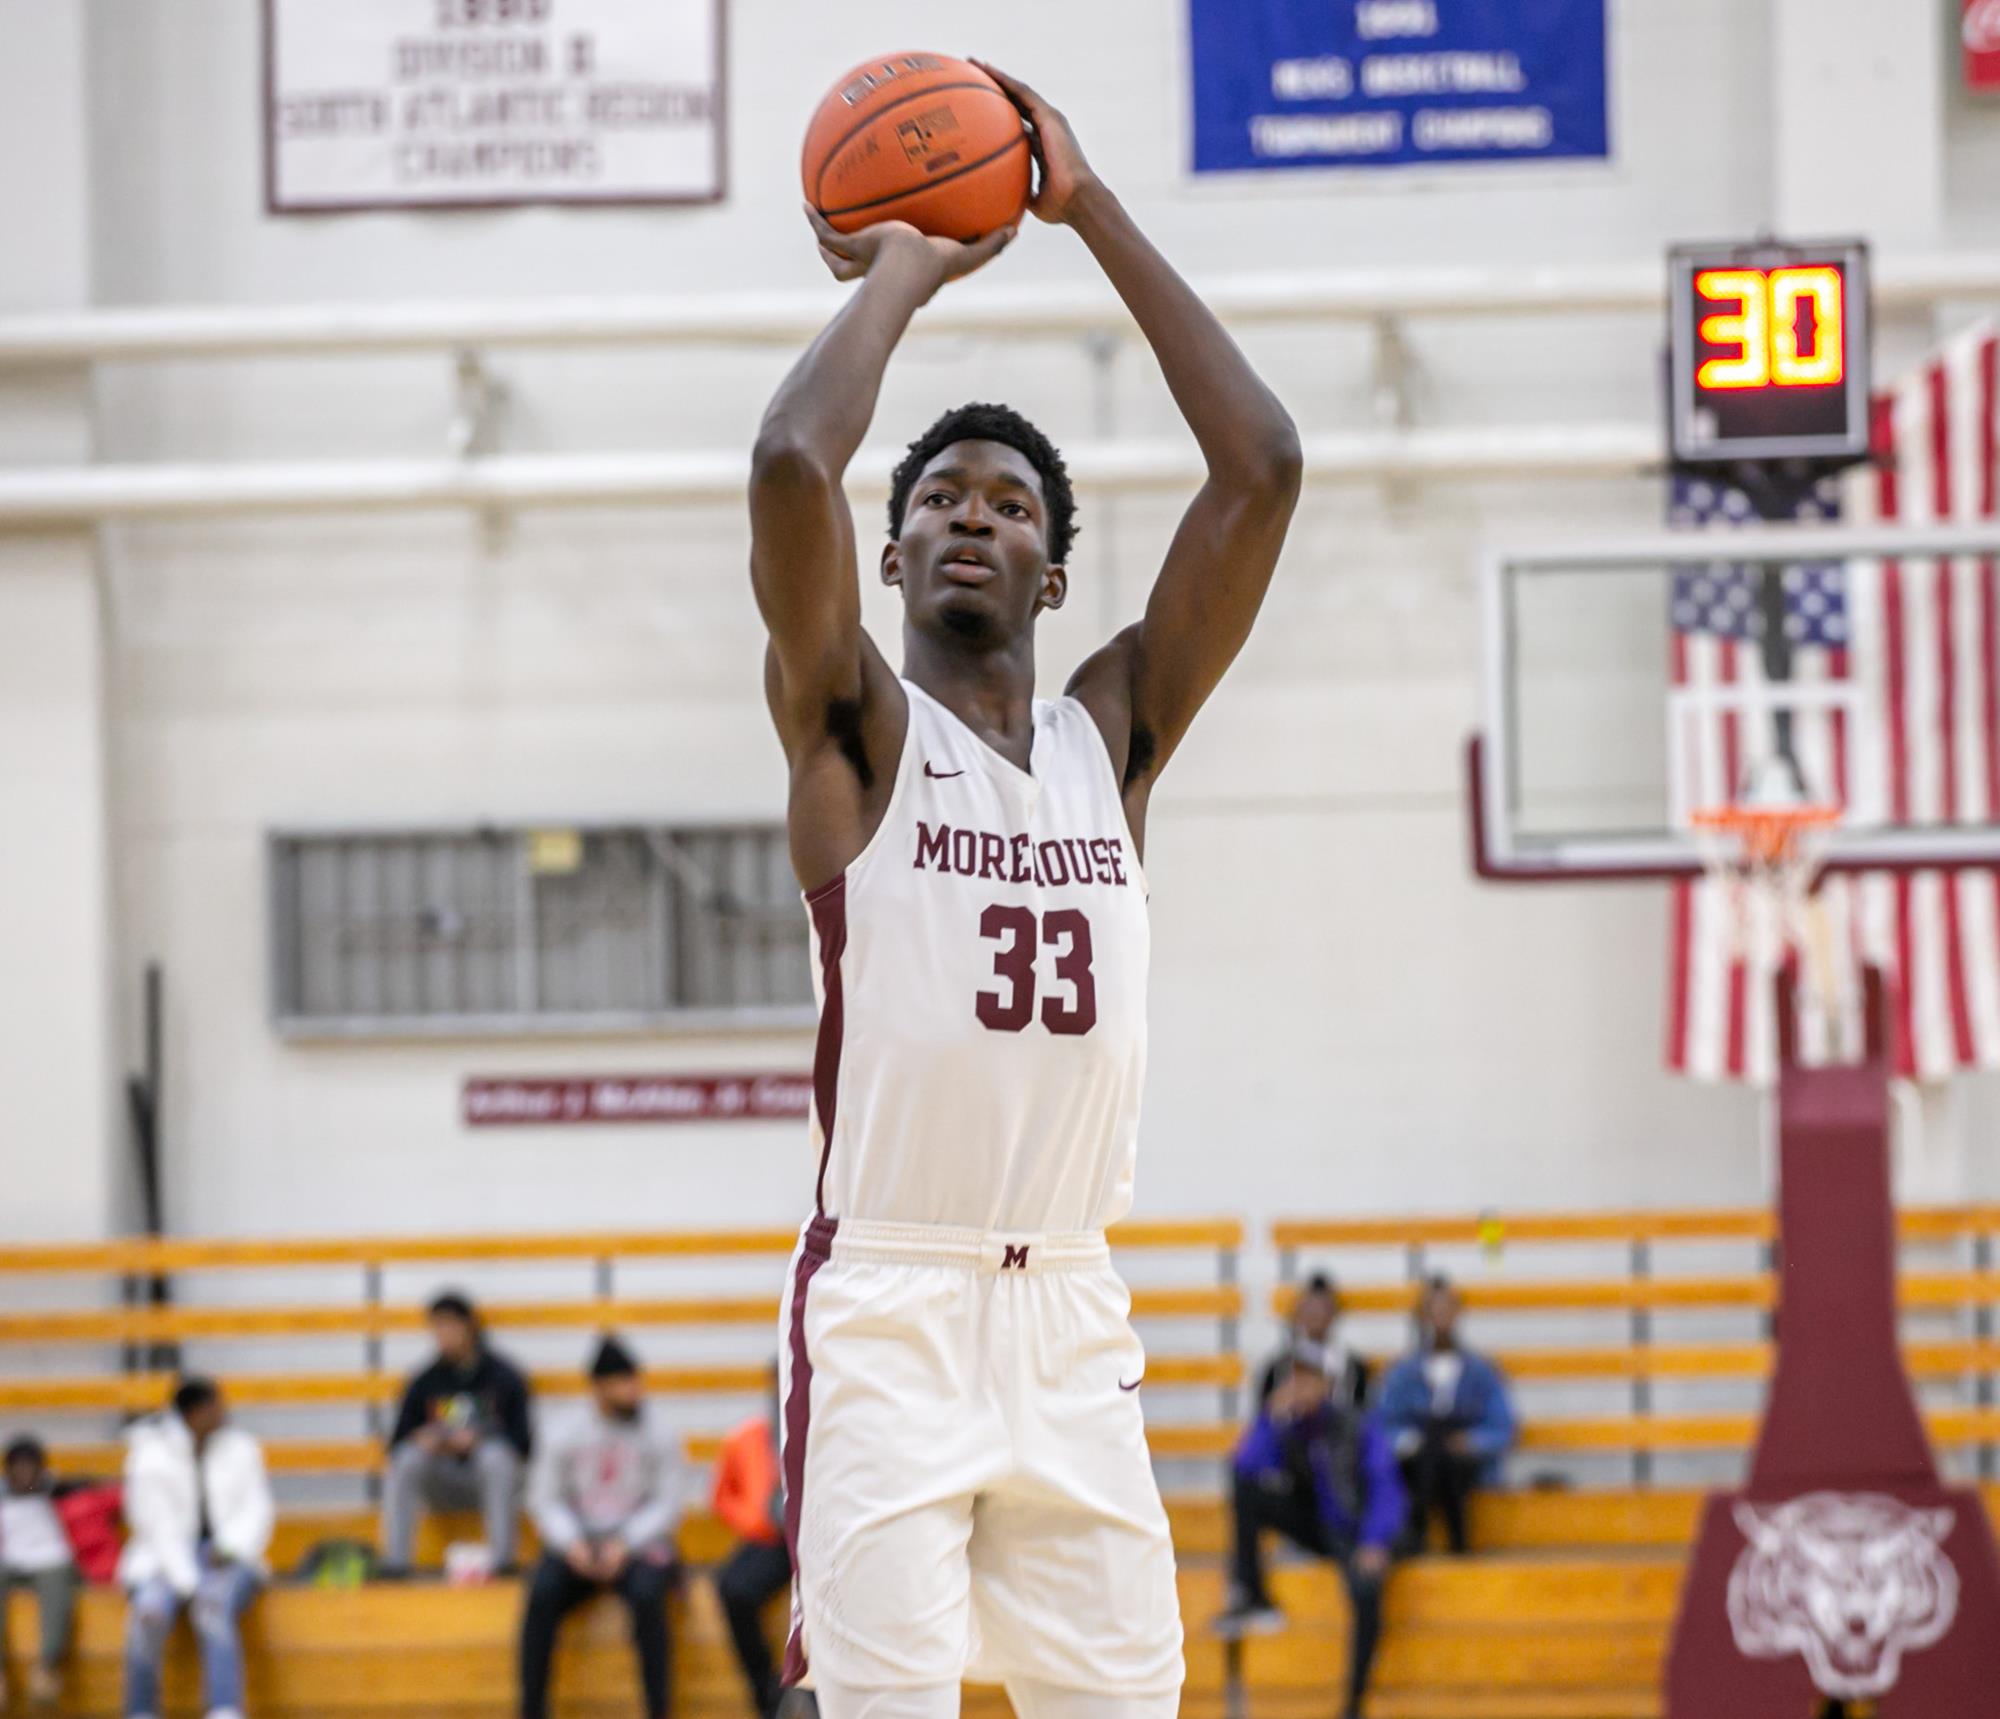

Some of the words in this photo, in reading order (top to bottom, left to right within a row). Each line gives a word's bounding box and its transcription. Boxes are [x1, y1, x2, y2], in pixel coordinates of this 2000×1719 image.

[1696, 267, 1844, 388] 30
[913, 821, 1128, 887] MOREOUSE
[975, 903, 1097, 1036] 33
[1001, 1244, 1030, 1269] M
